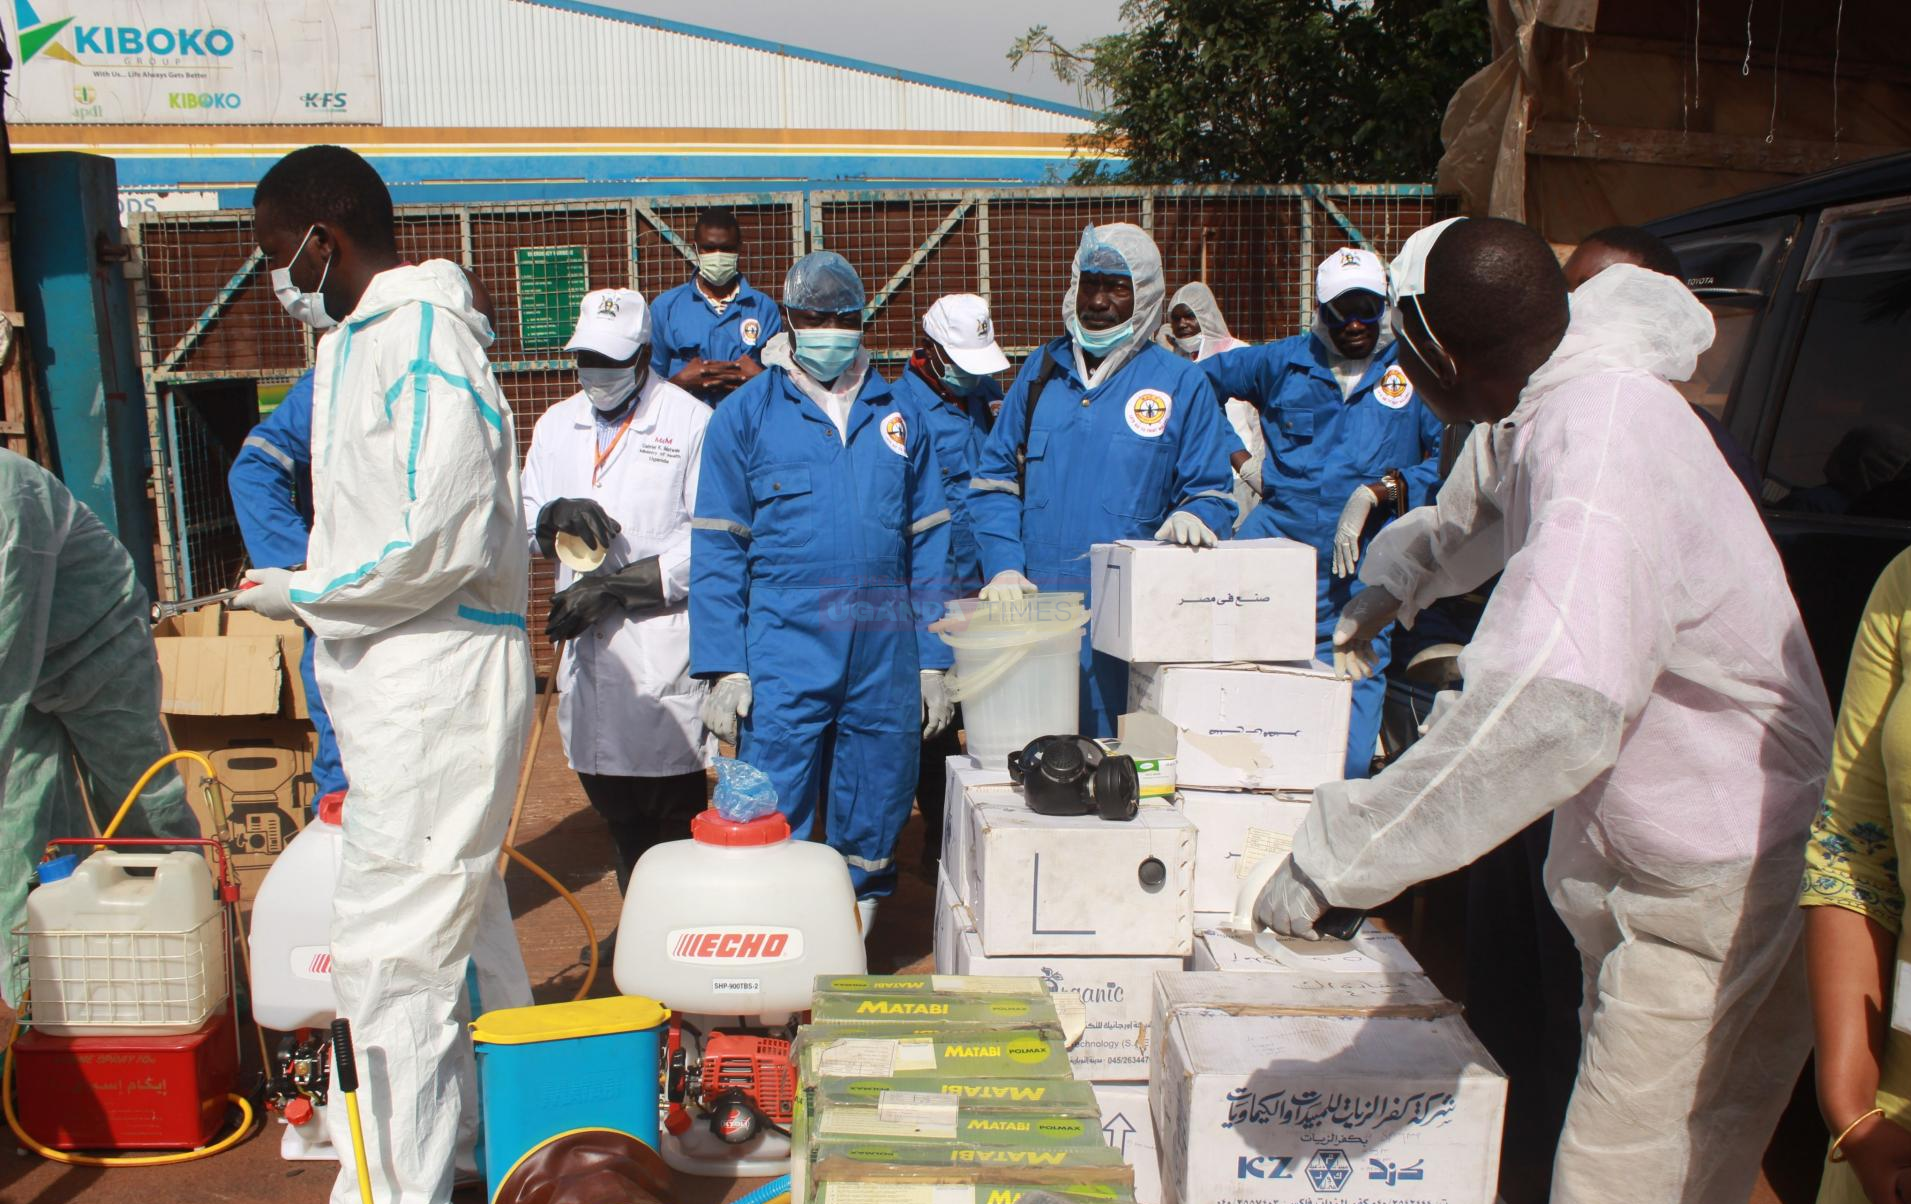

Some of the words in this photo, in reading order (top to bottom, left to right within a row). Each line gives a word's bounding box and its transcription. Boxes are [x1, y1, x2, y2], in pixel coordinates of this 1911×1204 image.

[74, 26, 234, 56] KIBOKO
[124, 57, 181, 66] GROUP
[142, 72, 167, 80] Always
[168, 92, 241, 110] KIBOKO
[304, 92, 348, 108] KFS
[1687, 277, 1714, 285] TOYOTA
[696, 934, 789, 957] ECHO
[856, 1000, 949, 1015] MATABI
[944, 1045, 1001, 1057] MATABI
[941, 1084, 1046, 1101] MATABI
[967, 1119, 1030, 1131] MATABI
[951, 1151, 1068, 1165] MATABI
[1237, 1156, 1293, 1178] KZ
